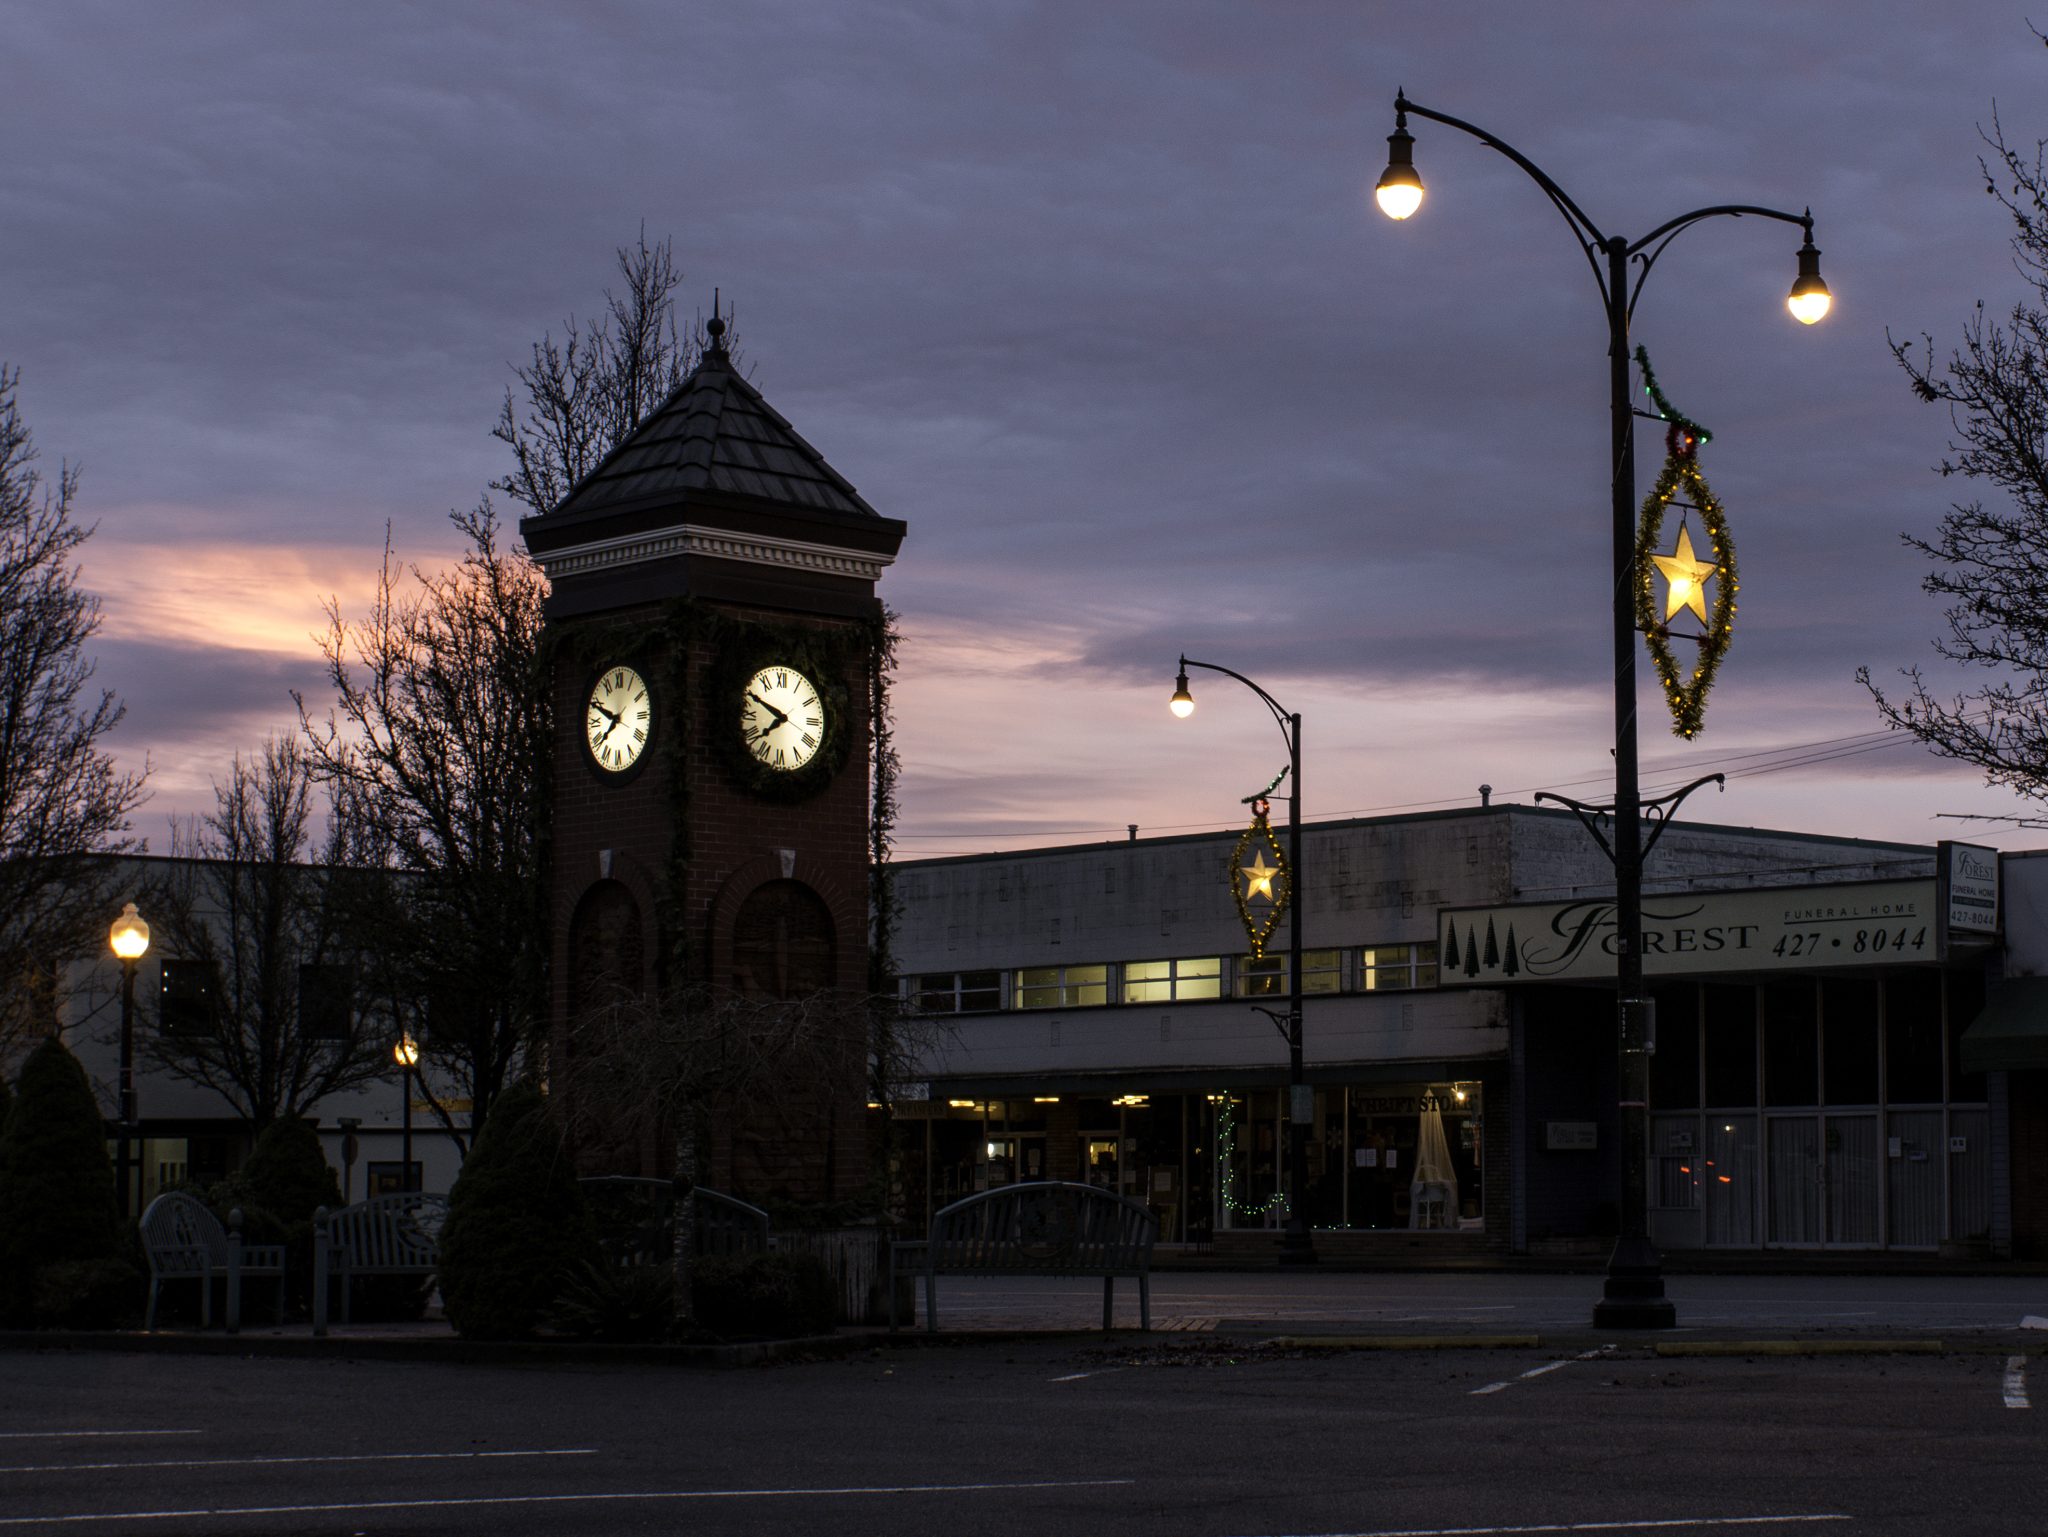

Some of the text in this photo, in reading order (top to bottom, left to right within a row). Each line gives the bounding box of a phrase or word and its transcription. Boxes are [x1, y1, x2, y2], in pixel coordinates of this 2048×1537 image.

[1957, 851, 1994, 879] FOREST
[1952, 884, 1995, 898] FUNERAL HOME
[1785, 903, 1915, 920] FUNERAL HOME
[1951, 911, 1994, 925] 427-8044
[1521, 900, 1759, 976] FOREST
[1358, 1096, 1416, 1113] THRIFT
